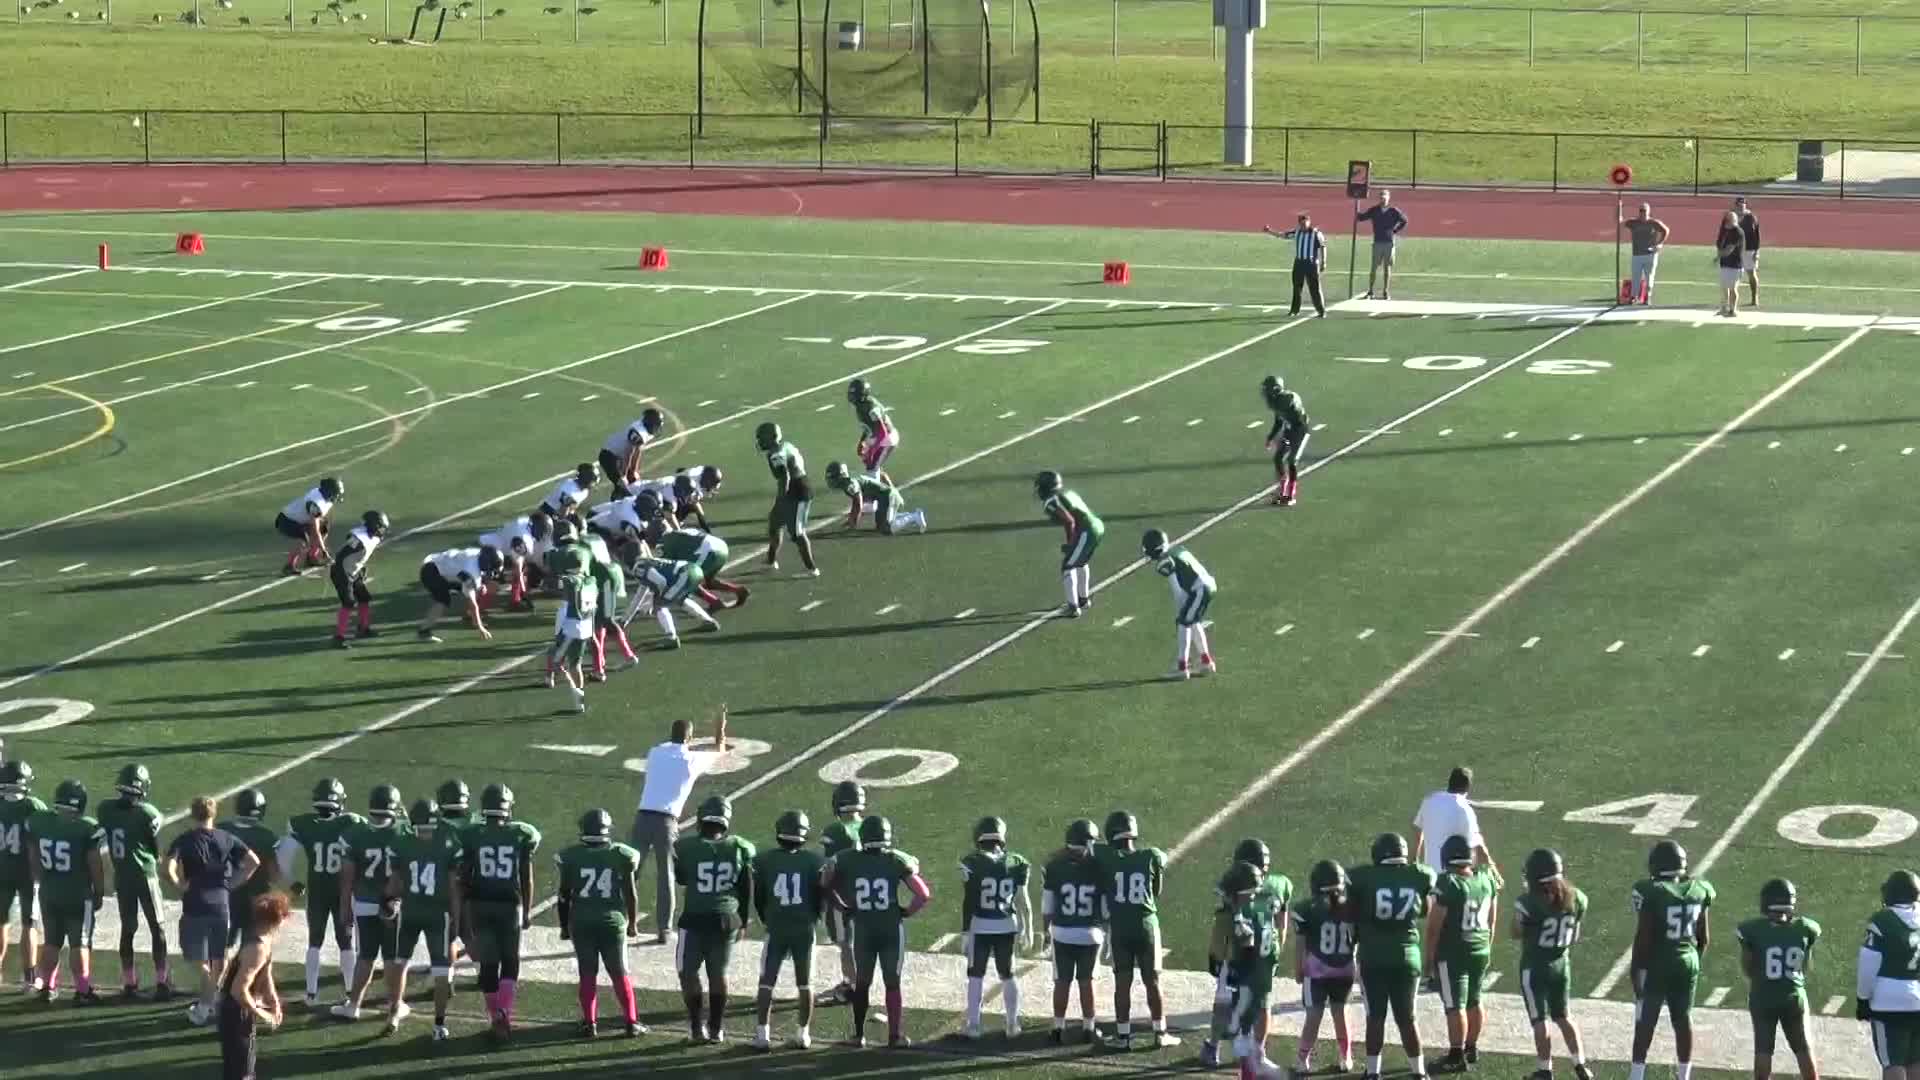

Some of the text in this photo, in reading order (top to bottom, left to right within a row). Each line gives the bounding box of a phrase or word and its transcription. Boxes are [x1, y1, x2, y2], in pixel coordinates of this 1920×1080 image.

[1104, 262, 1125, 281] 20
[1562, 792, 1919, 848] 40
[39, 837, 71, 871] 55
[313, 842, 341, 874] 16
[479, 846, 514, 879] 65
[408, 861, 436, 896] 14
[579, 867, 612, 898] 74
[697, 861, 733, 893] 52
[773, 873, 802, 905] 41
[855, 877, 889, 910] 23
[1113, 871, 1145, 904] 18
[1060, 883, 1096, 916] 35
[1375, 887, 1415, 920] 67
[1766, 946, 1804, 980] 69
